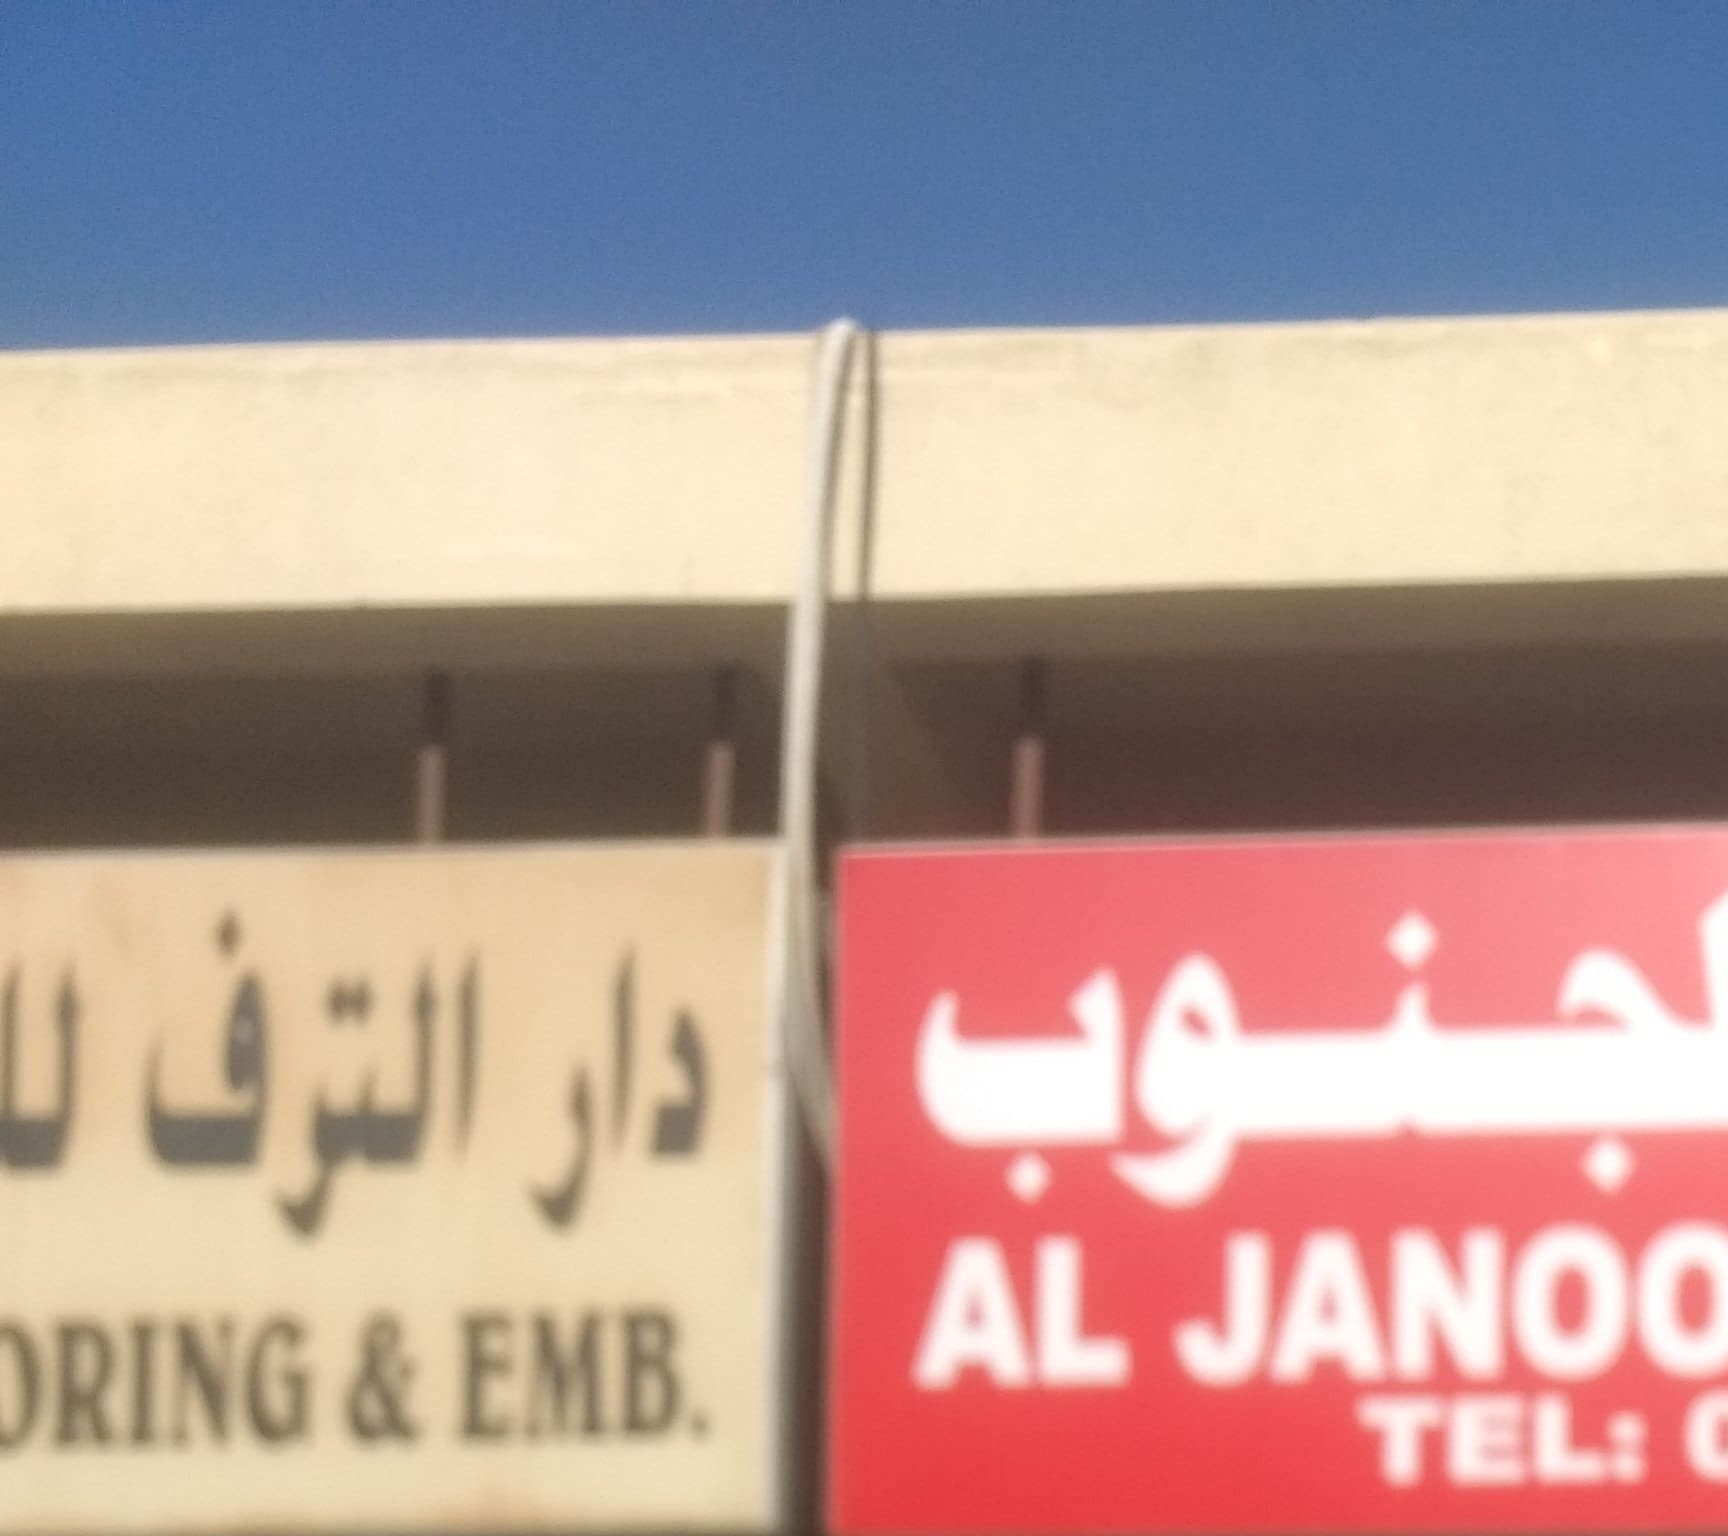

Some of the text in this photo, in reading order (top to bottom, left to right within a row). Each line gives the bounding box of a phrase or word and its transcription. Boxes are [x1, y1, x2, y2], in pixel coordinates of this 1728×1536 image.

[142, 908, 482, 1244] الترف
[528, 940, 712, 1236] دار
[342, 1310, 424, 1450] &
[457, 1302, 710, 1446] EMB.
[912, 1234, 1132, 1388] AL
[1356, 1392, 1648, 1486] TEL:
